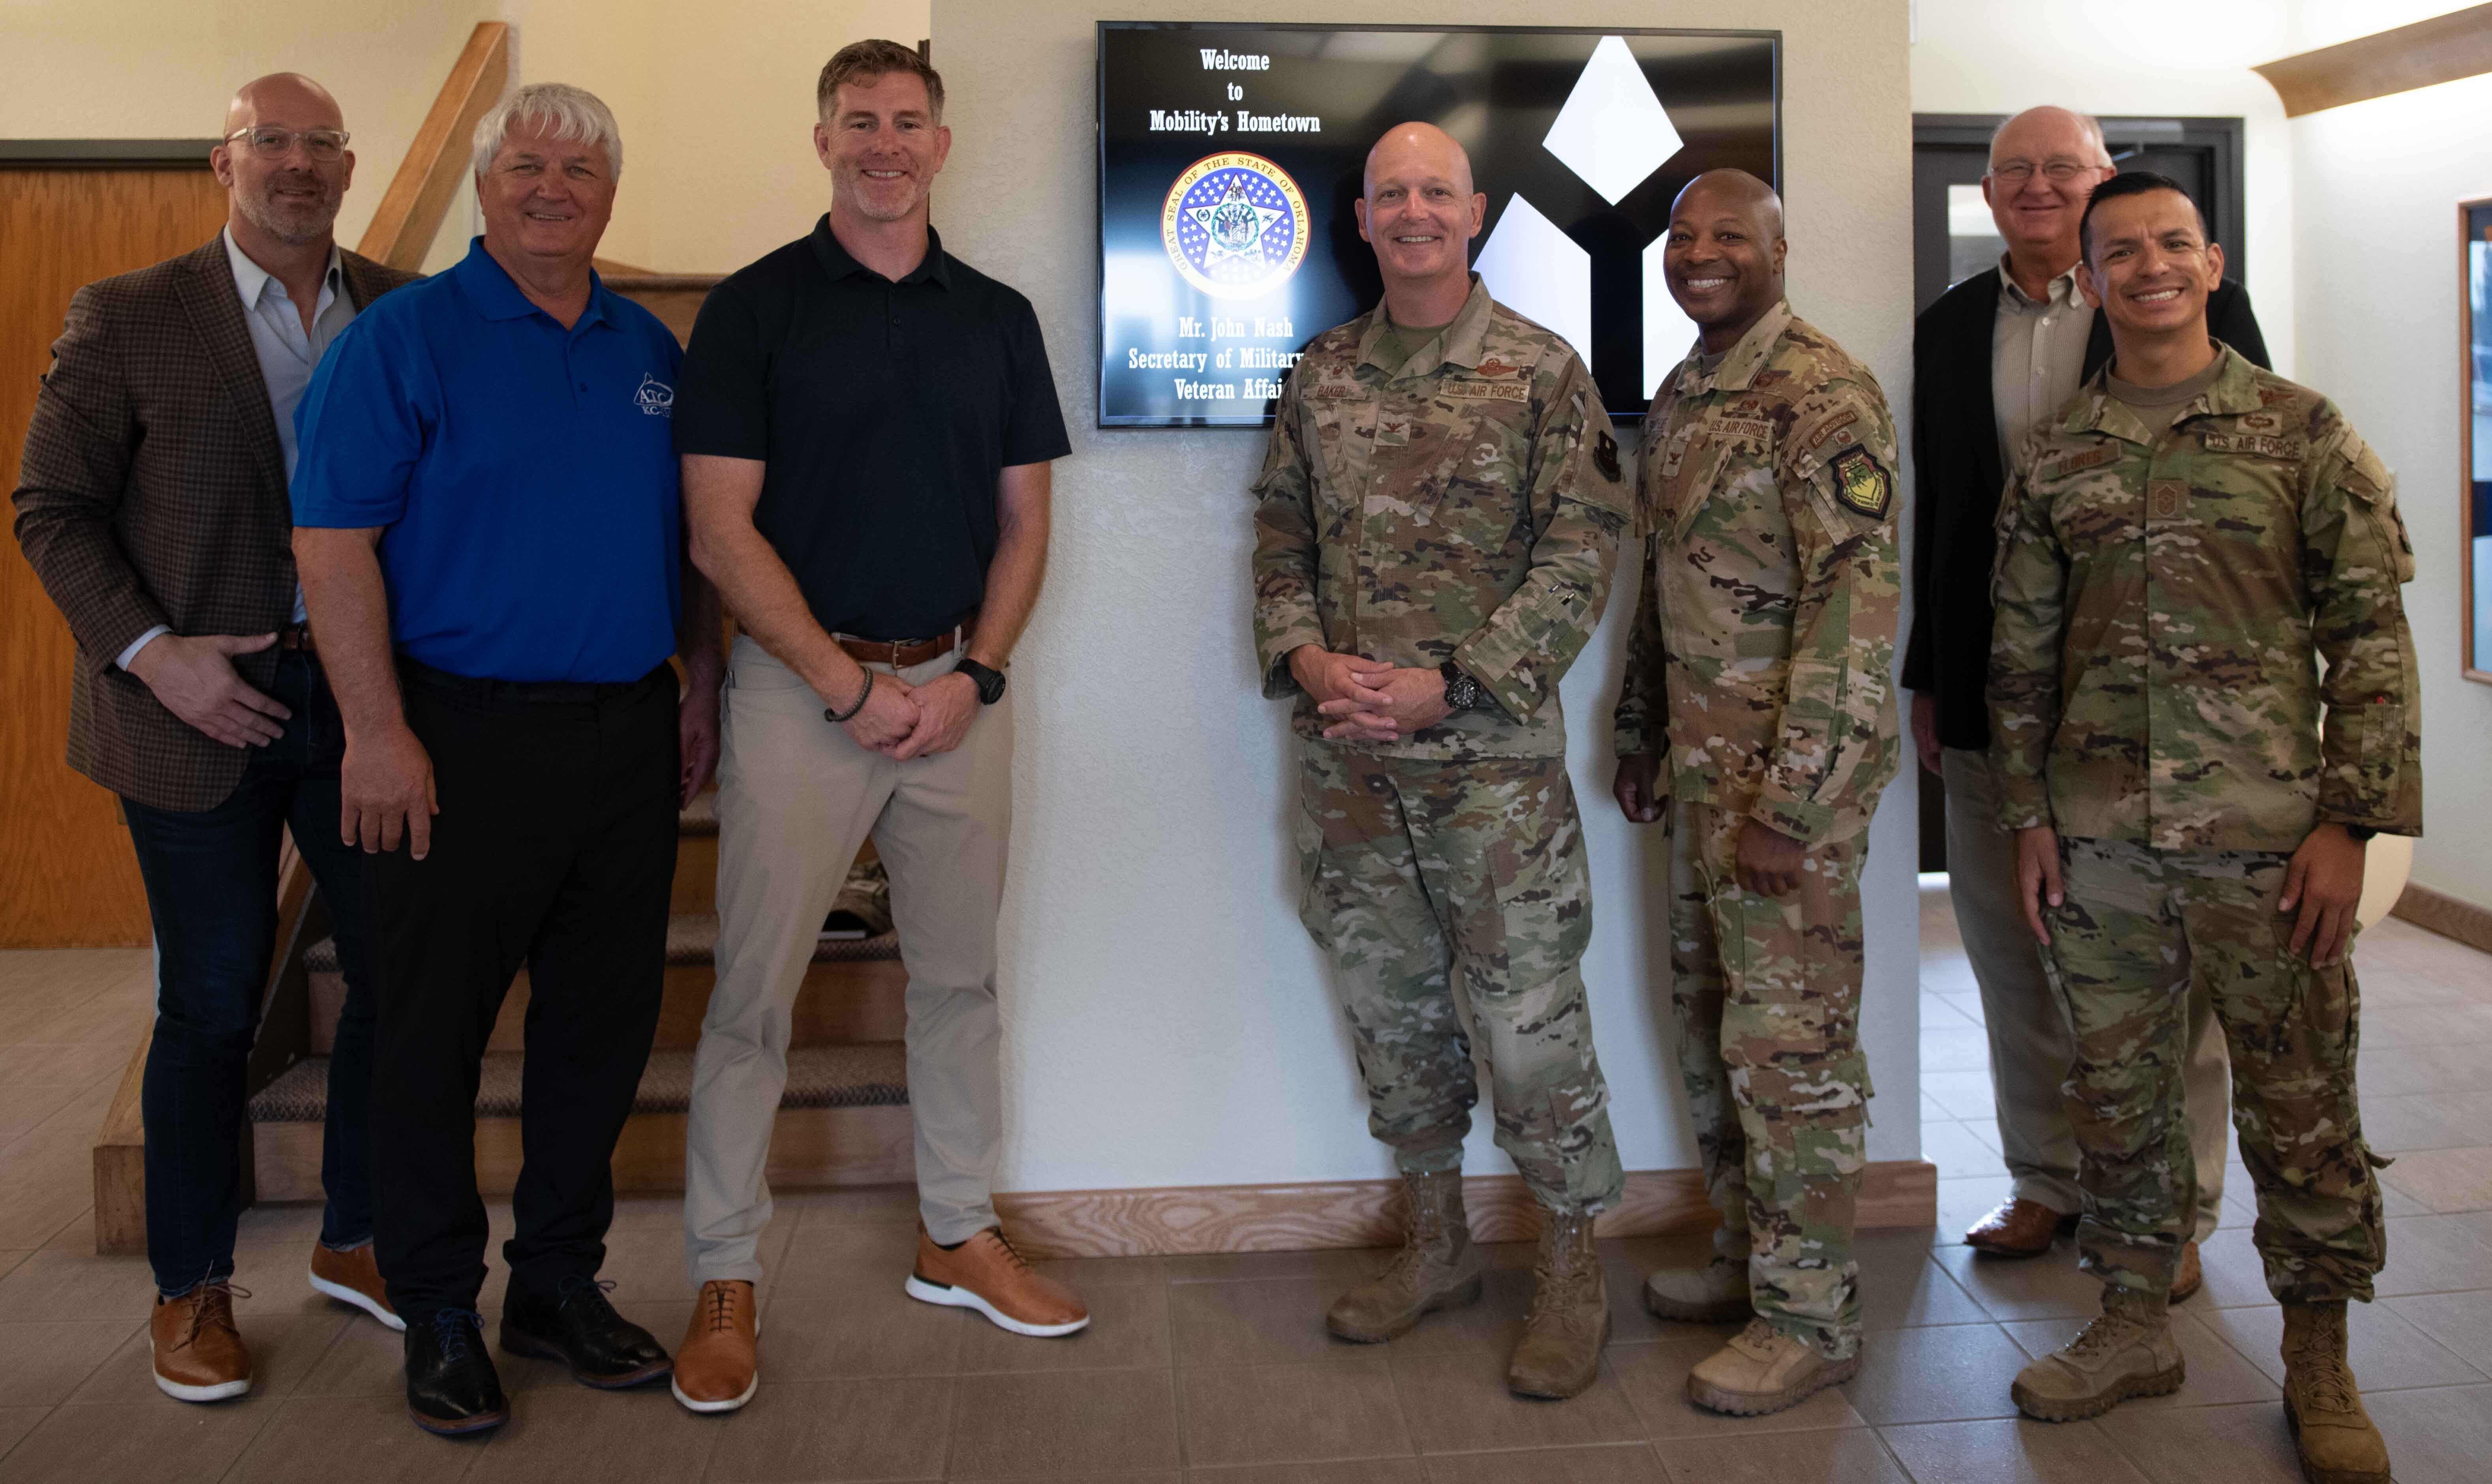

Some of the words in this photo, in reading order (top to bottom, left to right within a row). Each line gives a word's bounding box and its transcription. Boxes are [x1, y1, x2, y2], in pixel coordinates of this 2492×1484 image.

[1200, 49, 1269, 70] Welcome
[1227, 82, 1243, 100] to
[1149, 110, 1229, 135] Mobility's
[1237, 111, 1320, 132] Hometown
[1204, 158, 1230, 171] THE
[1238, 158, 1276, 177] STATE
[1184, 170, 1198, 184] OF
[1279, 179, 1294, 193] OF
[1167, 190, 1183, 222] SEAL
[1166, 229, 1187, 269] GREAT
[1179, 317, 1205, 338] Mr.
[1211, 317, 1245, 342] John
[1254, 317, 1294, 338] Nash
[1129, 348, 1208, 372] Secretary
[1216, 348, 1233, 368] of
[1174, 379, 1235, 399] Veteran
[1243, 378, 1282, 399] Affai
[1316, 385, 1346, 398] BAKER
[1469, 385, 1487, 397] AIR
[1491, 385, 1526, 400] FORCE
[1722, 421, 1739, 434] AIR
[1738, 422, 1769, 439] FORCE
[2237, 436, 2256, 450] AIR
[2261, 436, 2300, 456] FORCE
